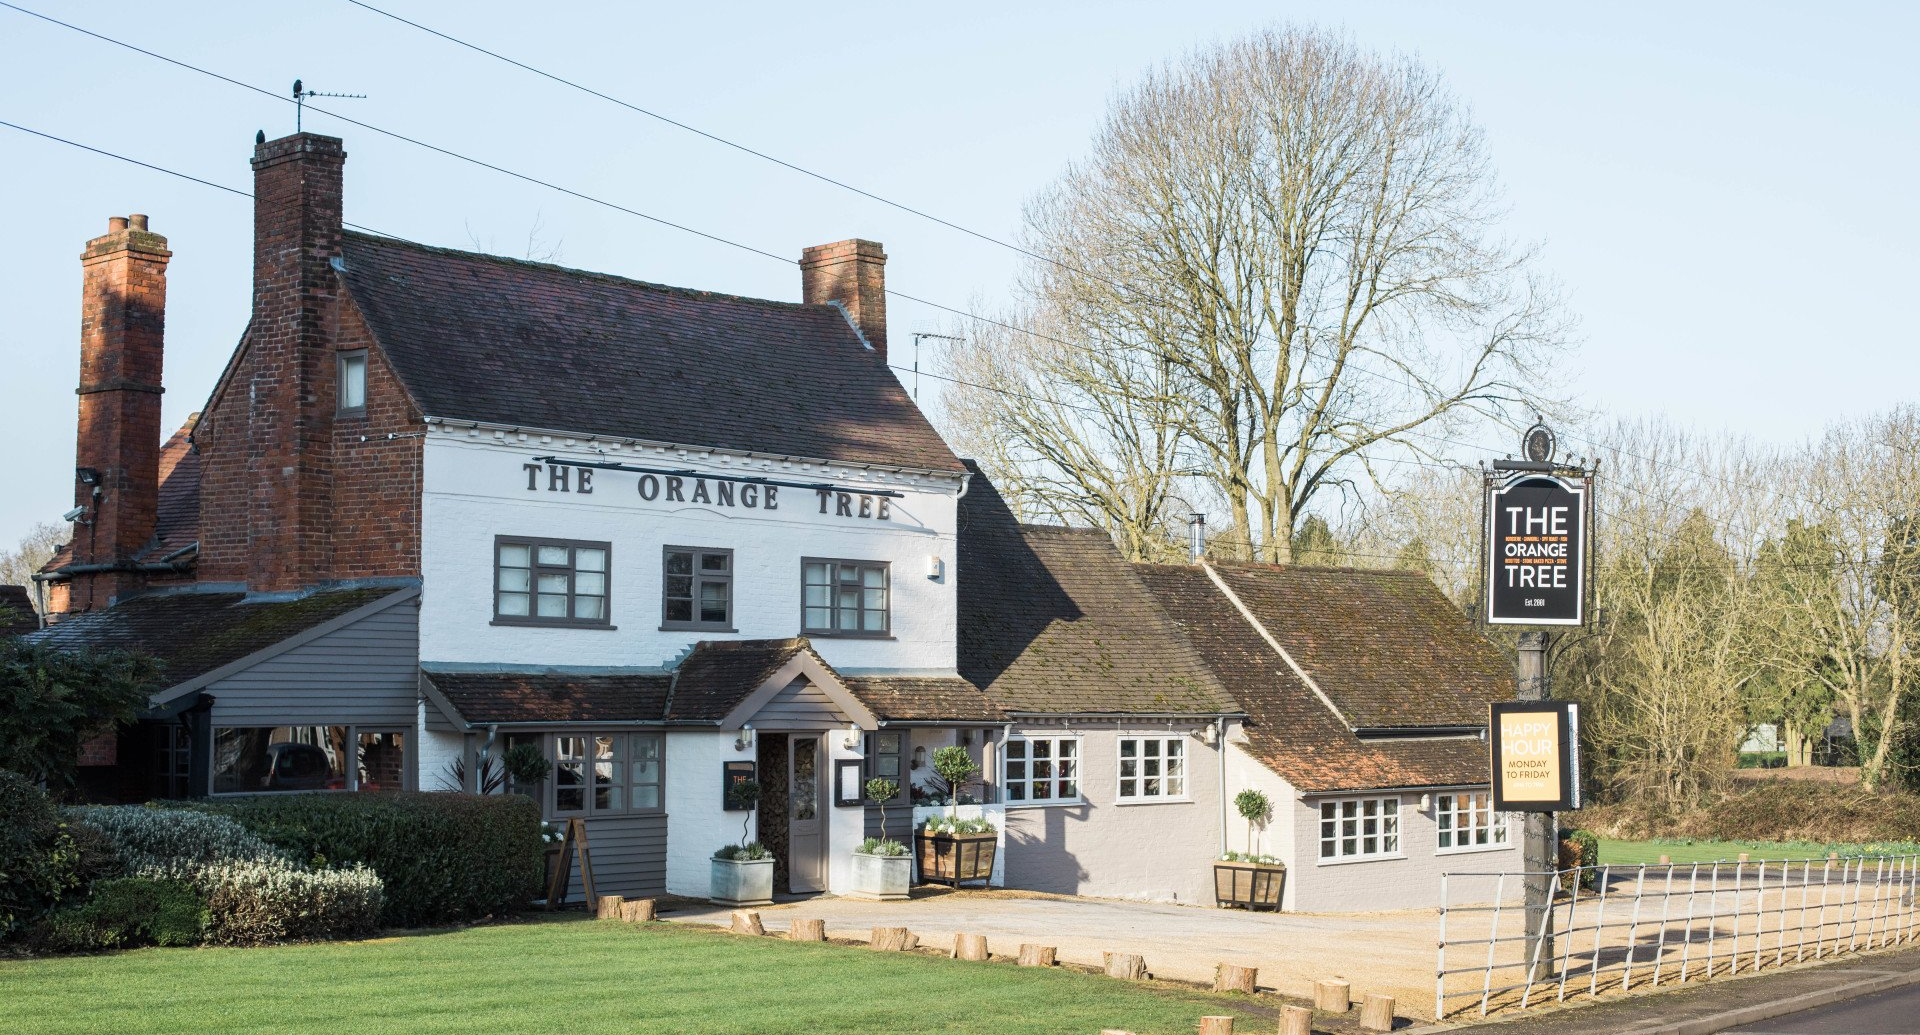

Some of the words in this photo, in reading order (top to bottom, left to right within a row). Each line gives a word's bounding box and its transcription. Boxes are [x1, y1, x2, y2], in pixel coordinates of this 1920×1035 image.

[523, 463, 594, 494] THE
[637, 474, 778, 510] ORANGE
[816, 489, 891, 520] TREE
[1506, 506, 1568, 535] THE
[1505, 543, 1568, 557] ORANGE
[1505, 565, 1567, 588] TREE
[1501, 723, 1552, 737] HAPPY
[1502, 739, 1553, 756] HOUR
[1508, 760, 1548, 768] MONDAY
[1506, 771, 1518, 779] TO
[1519, 771, 1551, 779] FRIDAY
